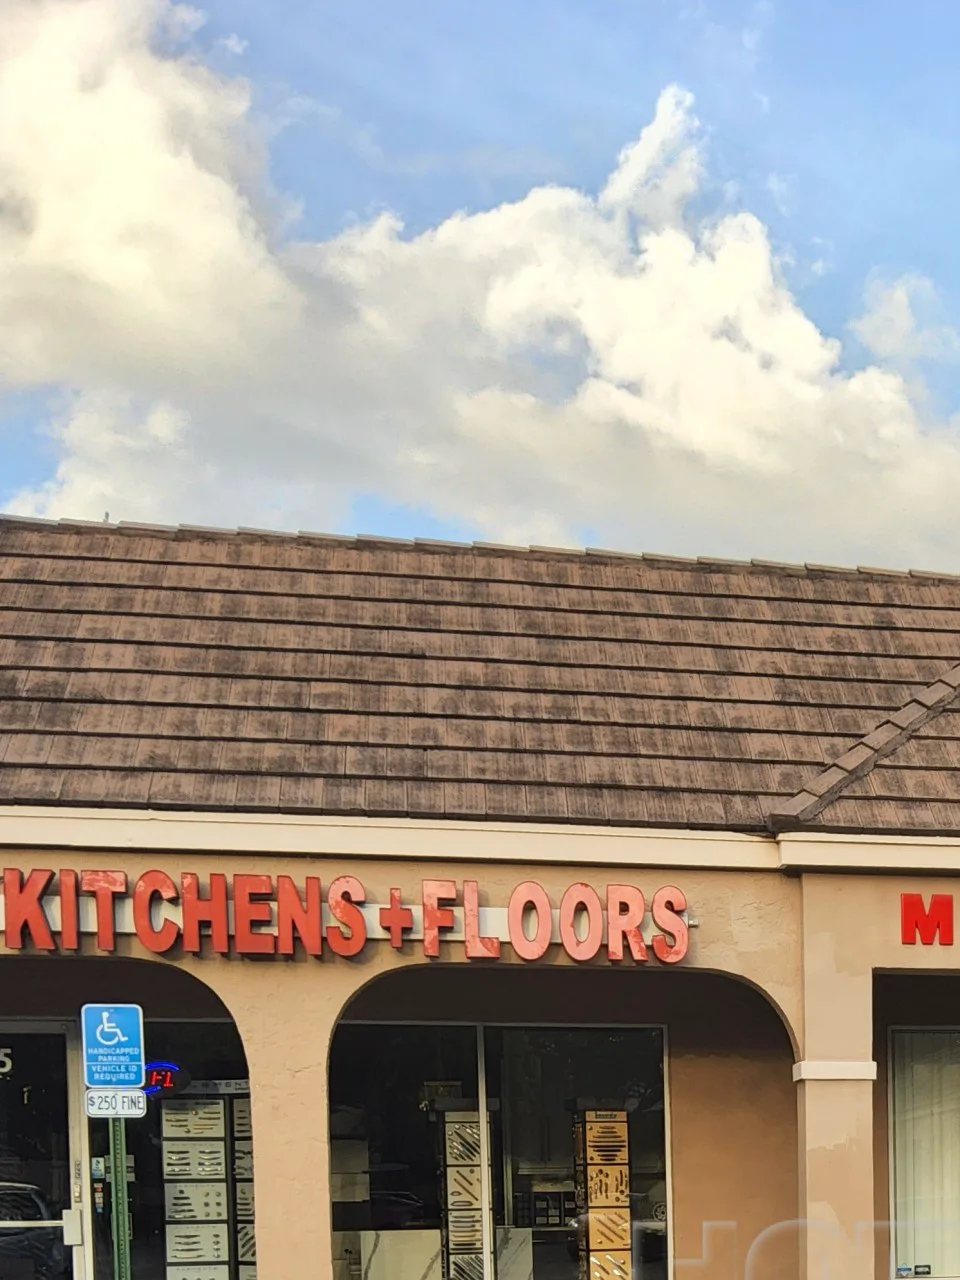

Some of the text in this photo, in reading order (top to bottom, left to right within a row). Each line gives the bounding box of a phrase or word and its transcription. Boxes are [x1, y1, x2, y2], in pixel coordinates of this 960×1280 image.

[87, 1047, 140, 1055] HANDICAPPED
[97, 1055, 130, 1063] PARKING
[93, 1072, 136, 1081] REQUIRED
[121, 1096, 145, 1111] FINE
